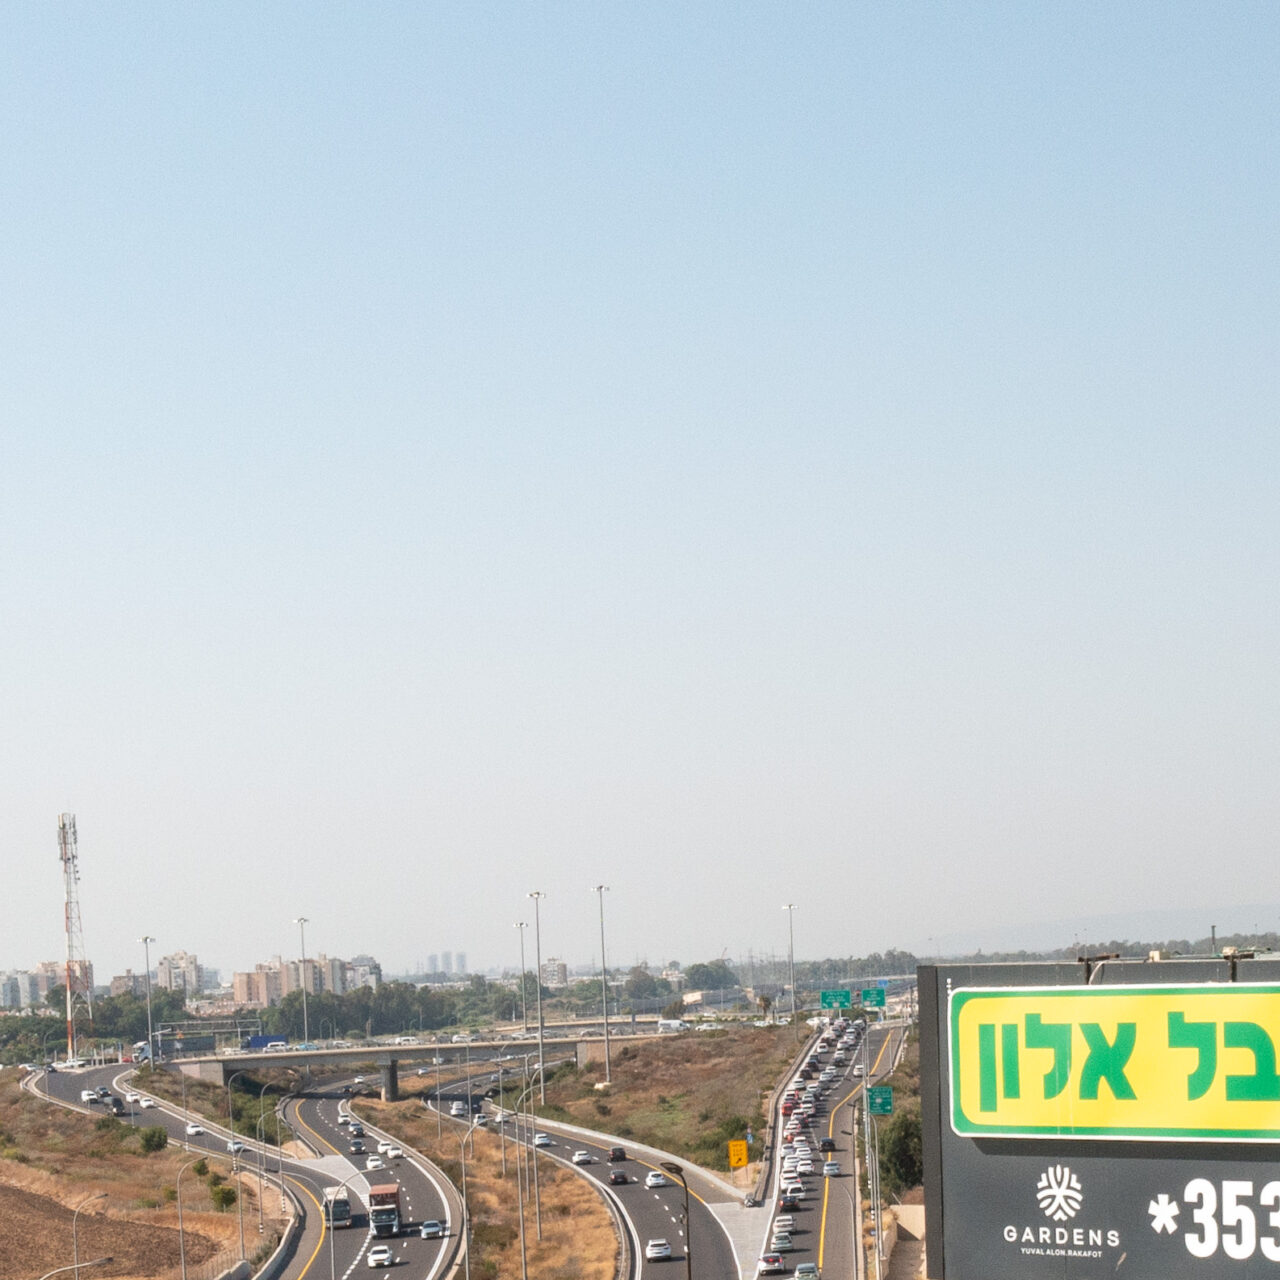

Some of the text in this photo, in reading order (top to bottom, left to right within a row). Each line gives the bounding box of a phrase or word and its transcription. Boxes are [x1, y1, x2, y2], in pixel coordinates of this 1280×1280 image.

[978, 1013, 1137, 1112] אלון
[1003, 1225, 1120, 1247] GARDENS
[1020, 1247, 1045, 1256] YUVAL
